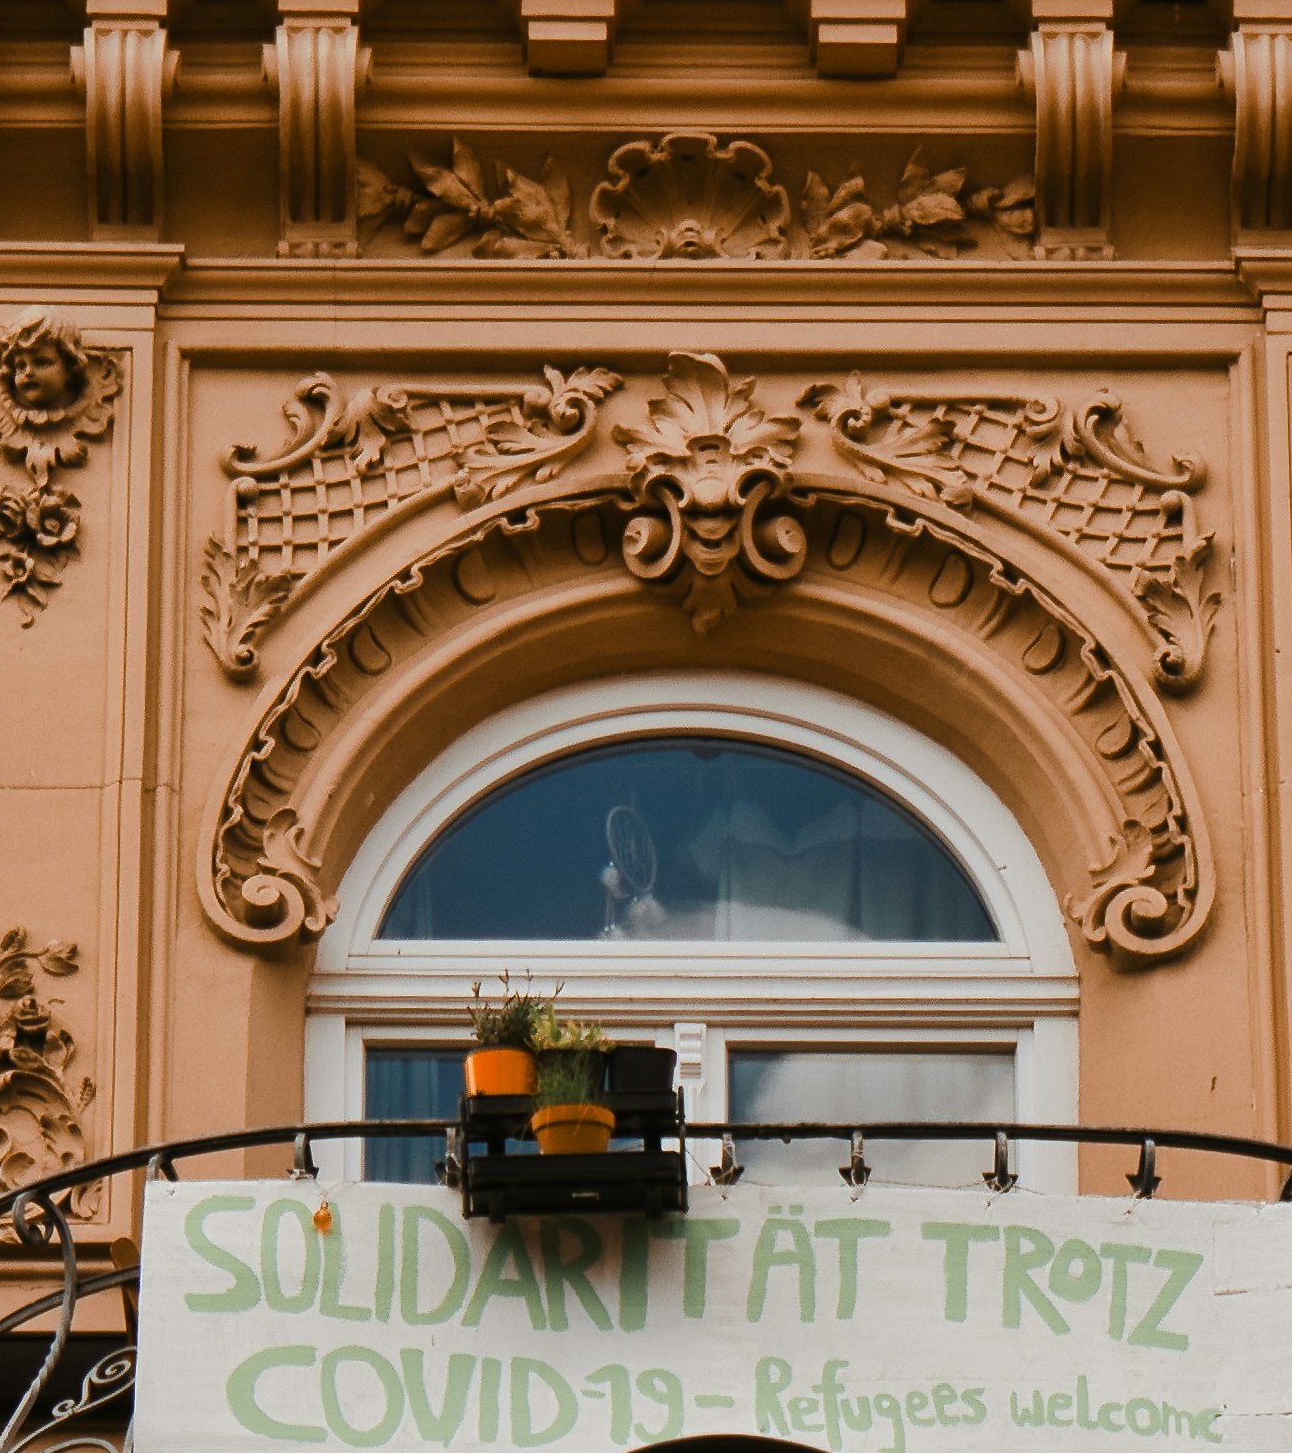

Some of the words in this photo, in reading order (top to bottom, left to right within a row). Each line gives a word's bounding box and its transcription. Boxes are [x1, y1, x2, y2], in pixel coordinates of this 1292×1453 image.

[183, 1196, 894, 1333] SOLIDARITÄT
[920, 1218, 1204, 1351] TROTZ
[225, 1345, 685, 1448] COVID-19
[1010, 1375, 1225, 1444] welcome
